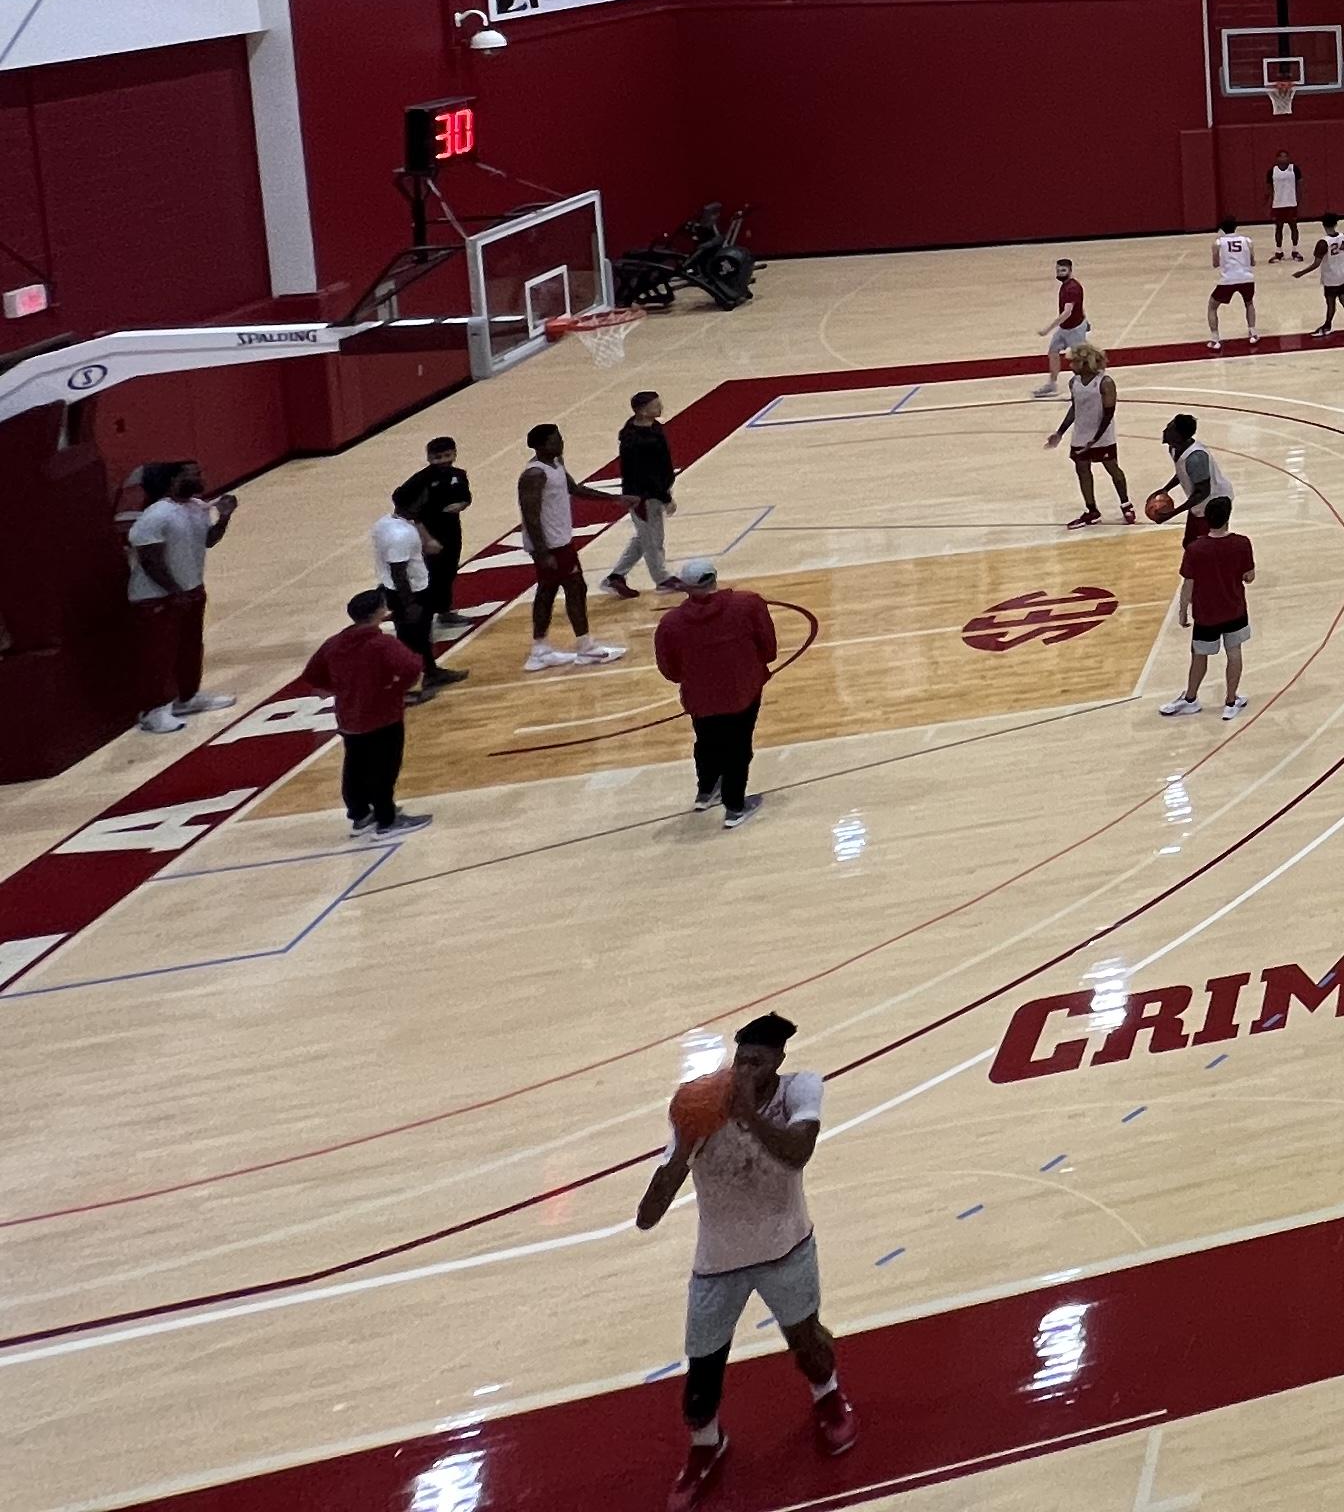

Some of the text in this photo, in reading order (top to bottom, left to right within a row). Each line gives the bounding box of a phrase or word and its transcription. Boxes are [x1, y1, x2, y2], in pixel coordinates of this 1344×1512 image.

[435, 109, 474, 160] 30
[1226, 240, 1243, 253] 15
[236, 329, 318, 346] SPALDING
